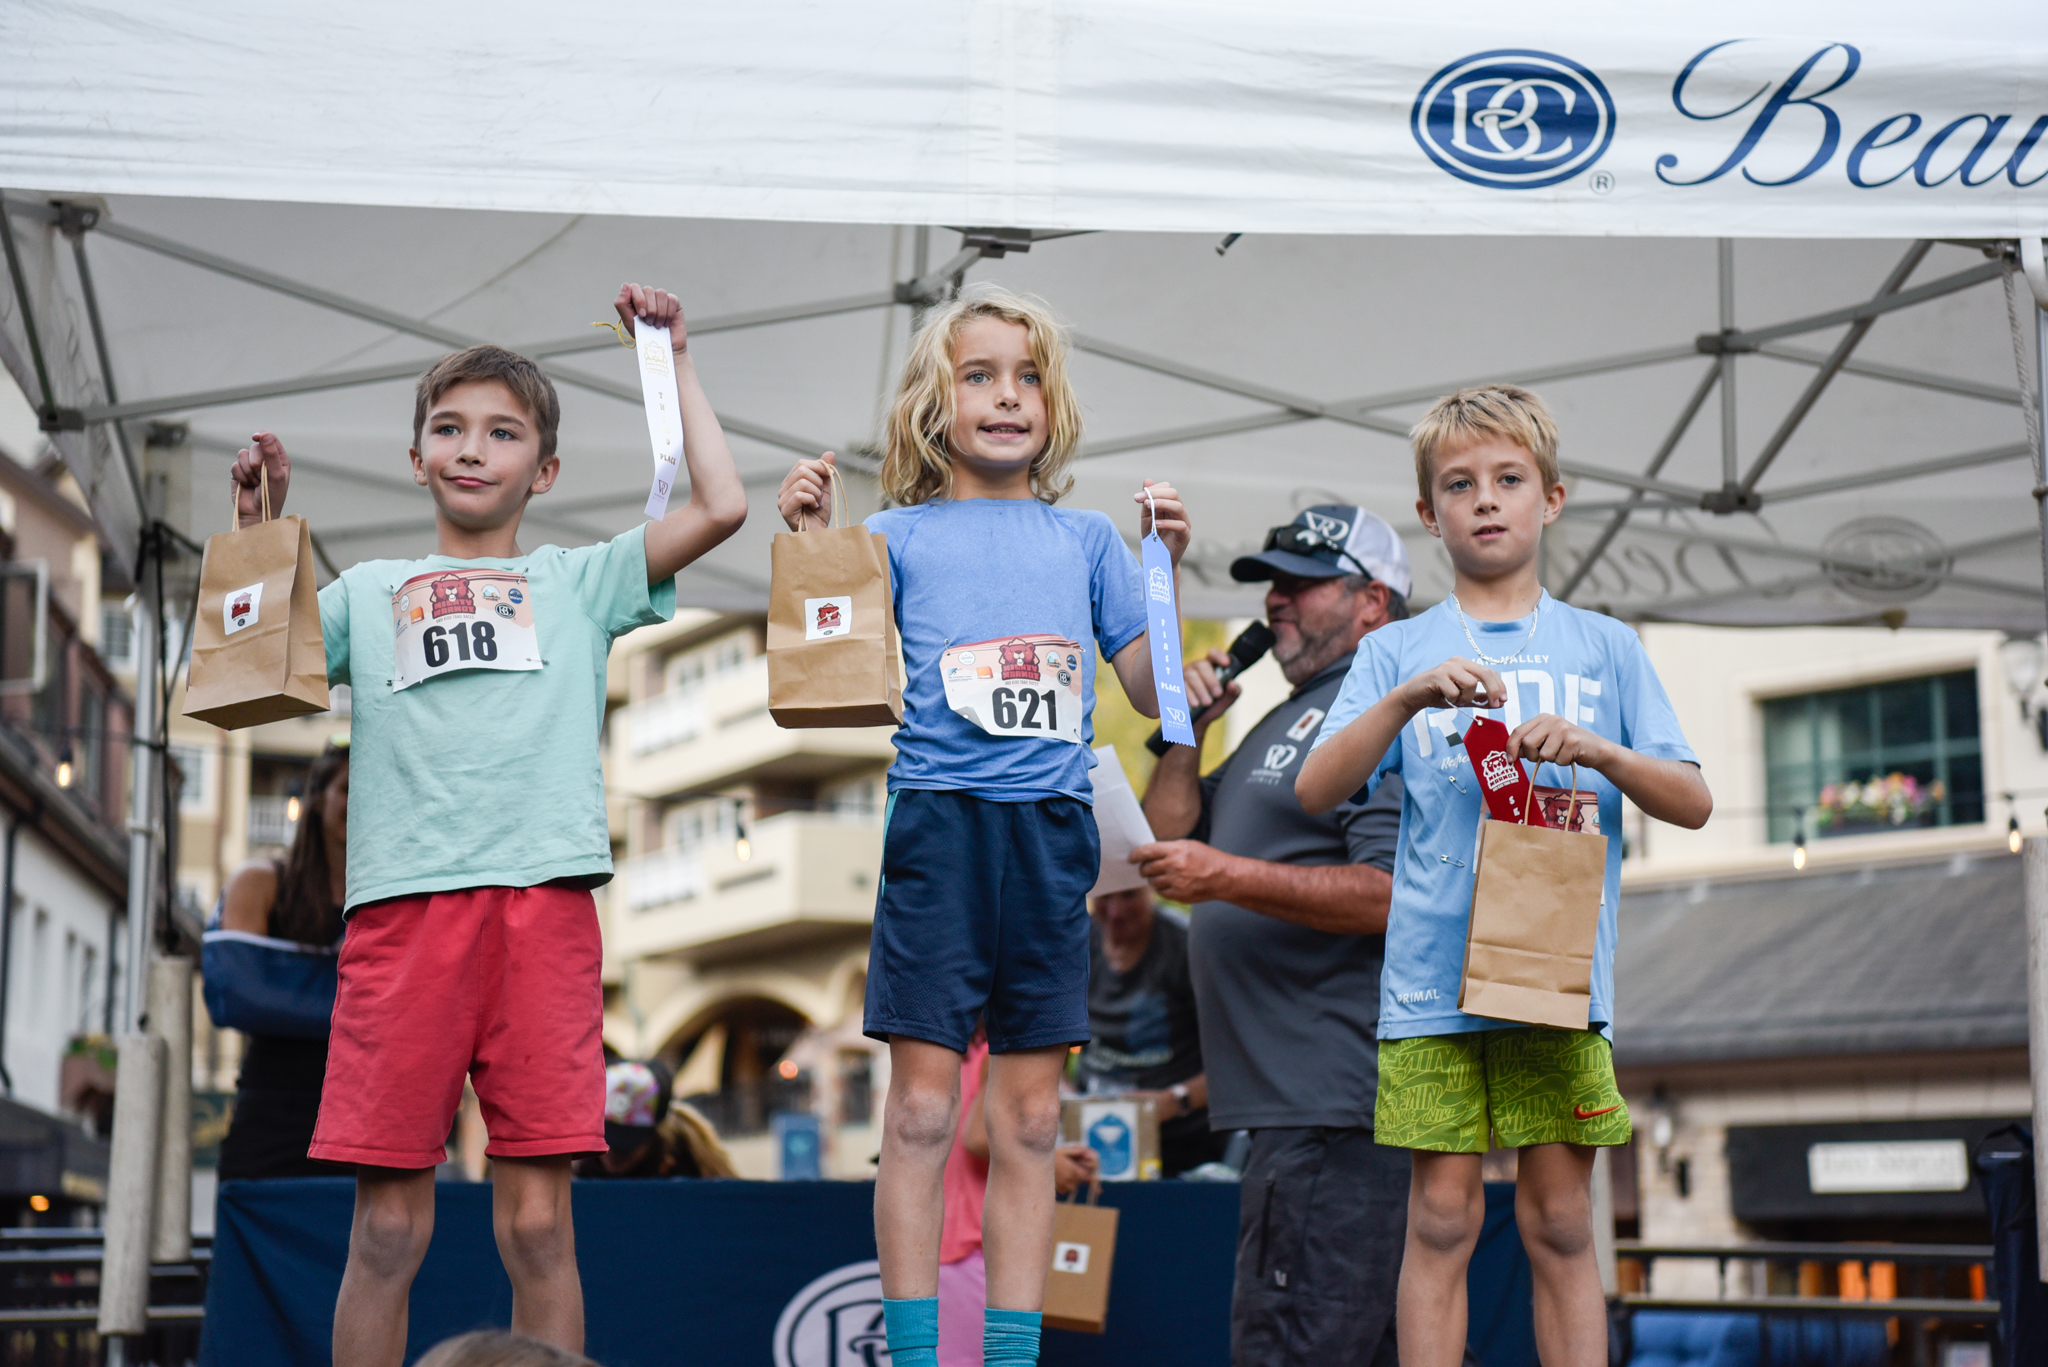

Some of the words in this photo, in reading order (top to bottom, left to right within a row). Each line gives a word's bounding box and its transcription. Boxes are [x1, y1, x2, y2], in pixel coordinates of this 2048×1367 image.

[432, 598, 474, 610] MIGHTY
[433, 605, 475, 619] MARMOT
[422, 621, 498, 668] 618
[1161, 618, 1171, 676] FIRST
[1002, 670, 1040, 681] MARMOT
[1161, 681, 1181, 694] PLACE
[992, 687, 1057, 731] 621
[1490, 772, 1517, 787] MARMOT
[1397, 988, 1440, 1004] PRIMAL
